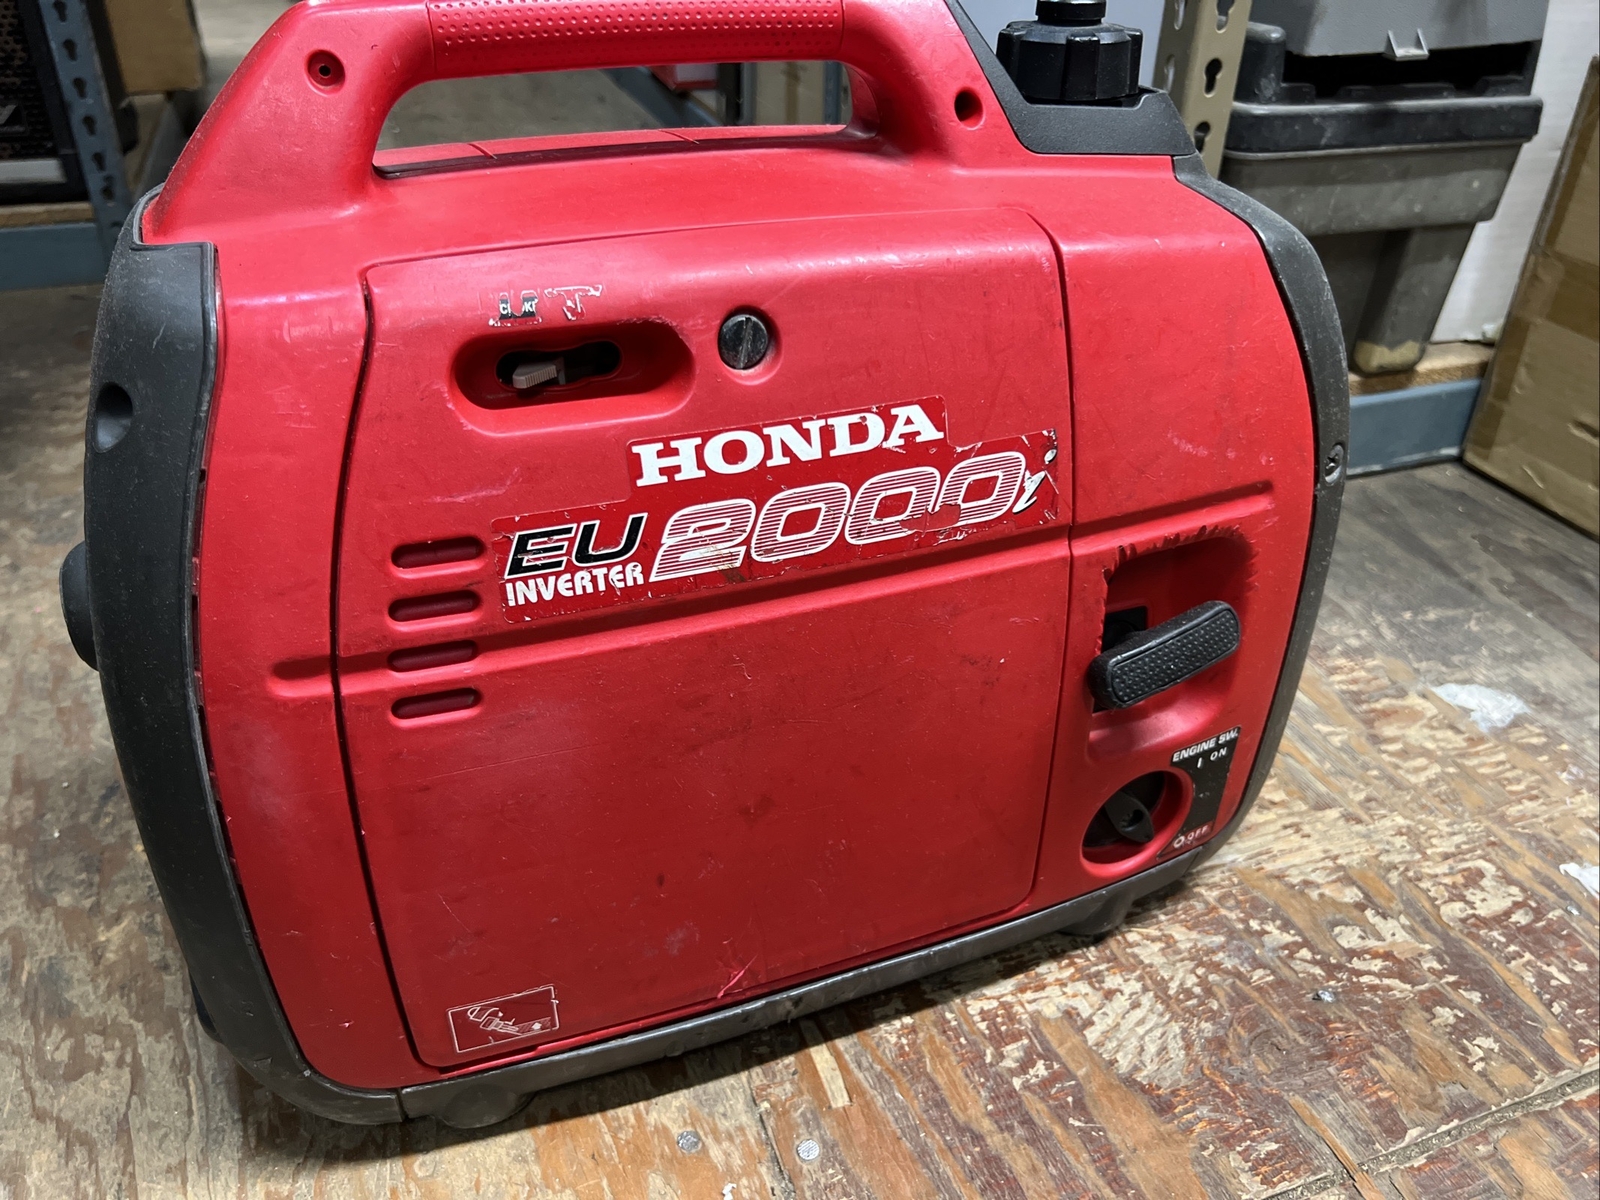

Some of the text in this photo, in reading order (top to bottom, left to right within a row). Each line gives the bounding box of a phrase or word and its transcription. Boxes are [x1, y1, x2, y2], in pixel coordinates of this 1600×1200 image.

[632, 404, 945, 487] HONDA
[504, 512, 649, 579] EU
[505, 561, 645, 607] INVERTER
[1172, 738, 1217, 763] ENGINE
[1209, 747, 1228, 761] ON
[1187, 825, 1209, 841] OFF
